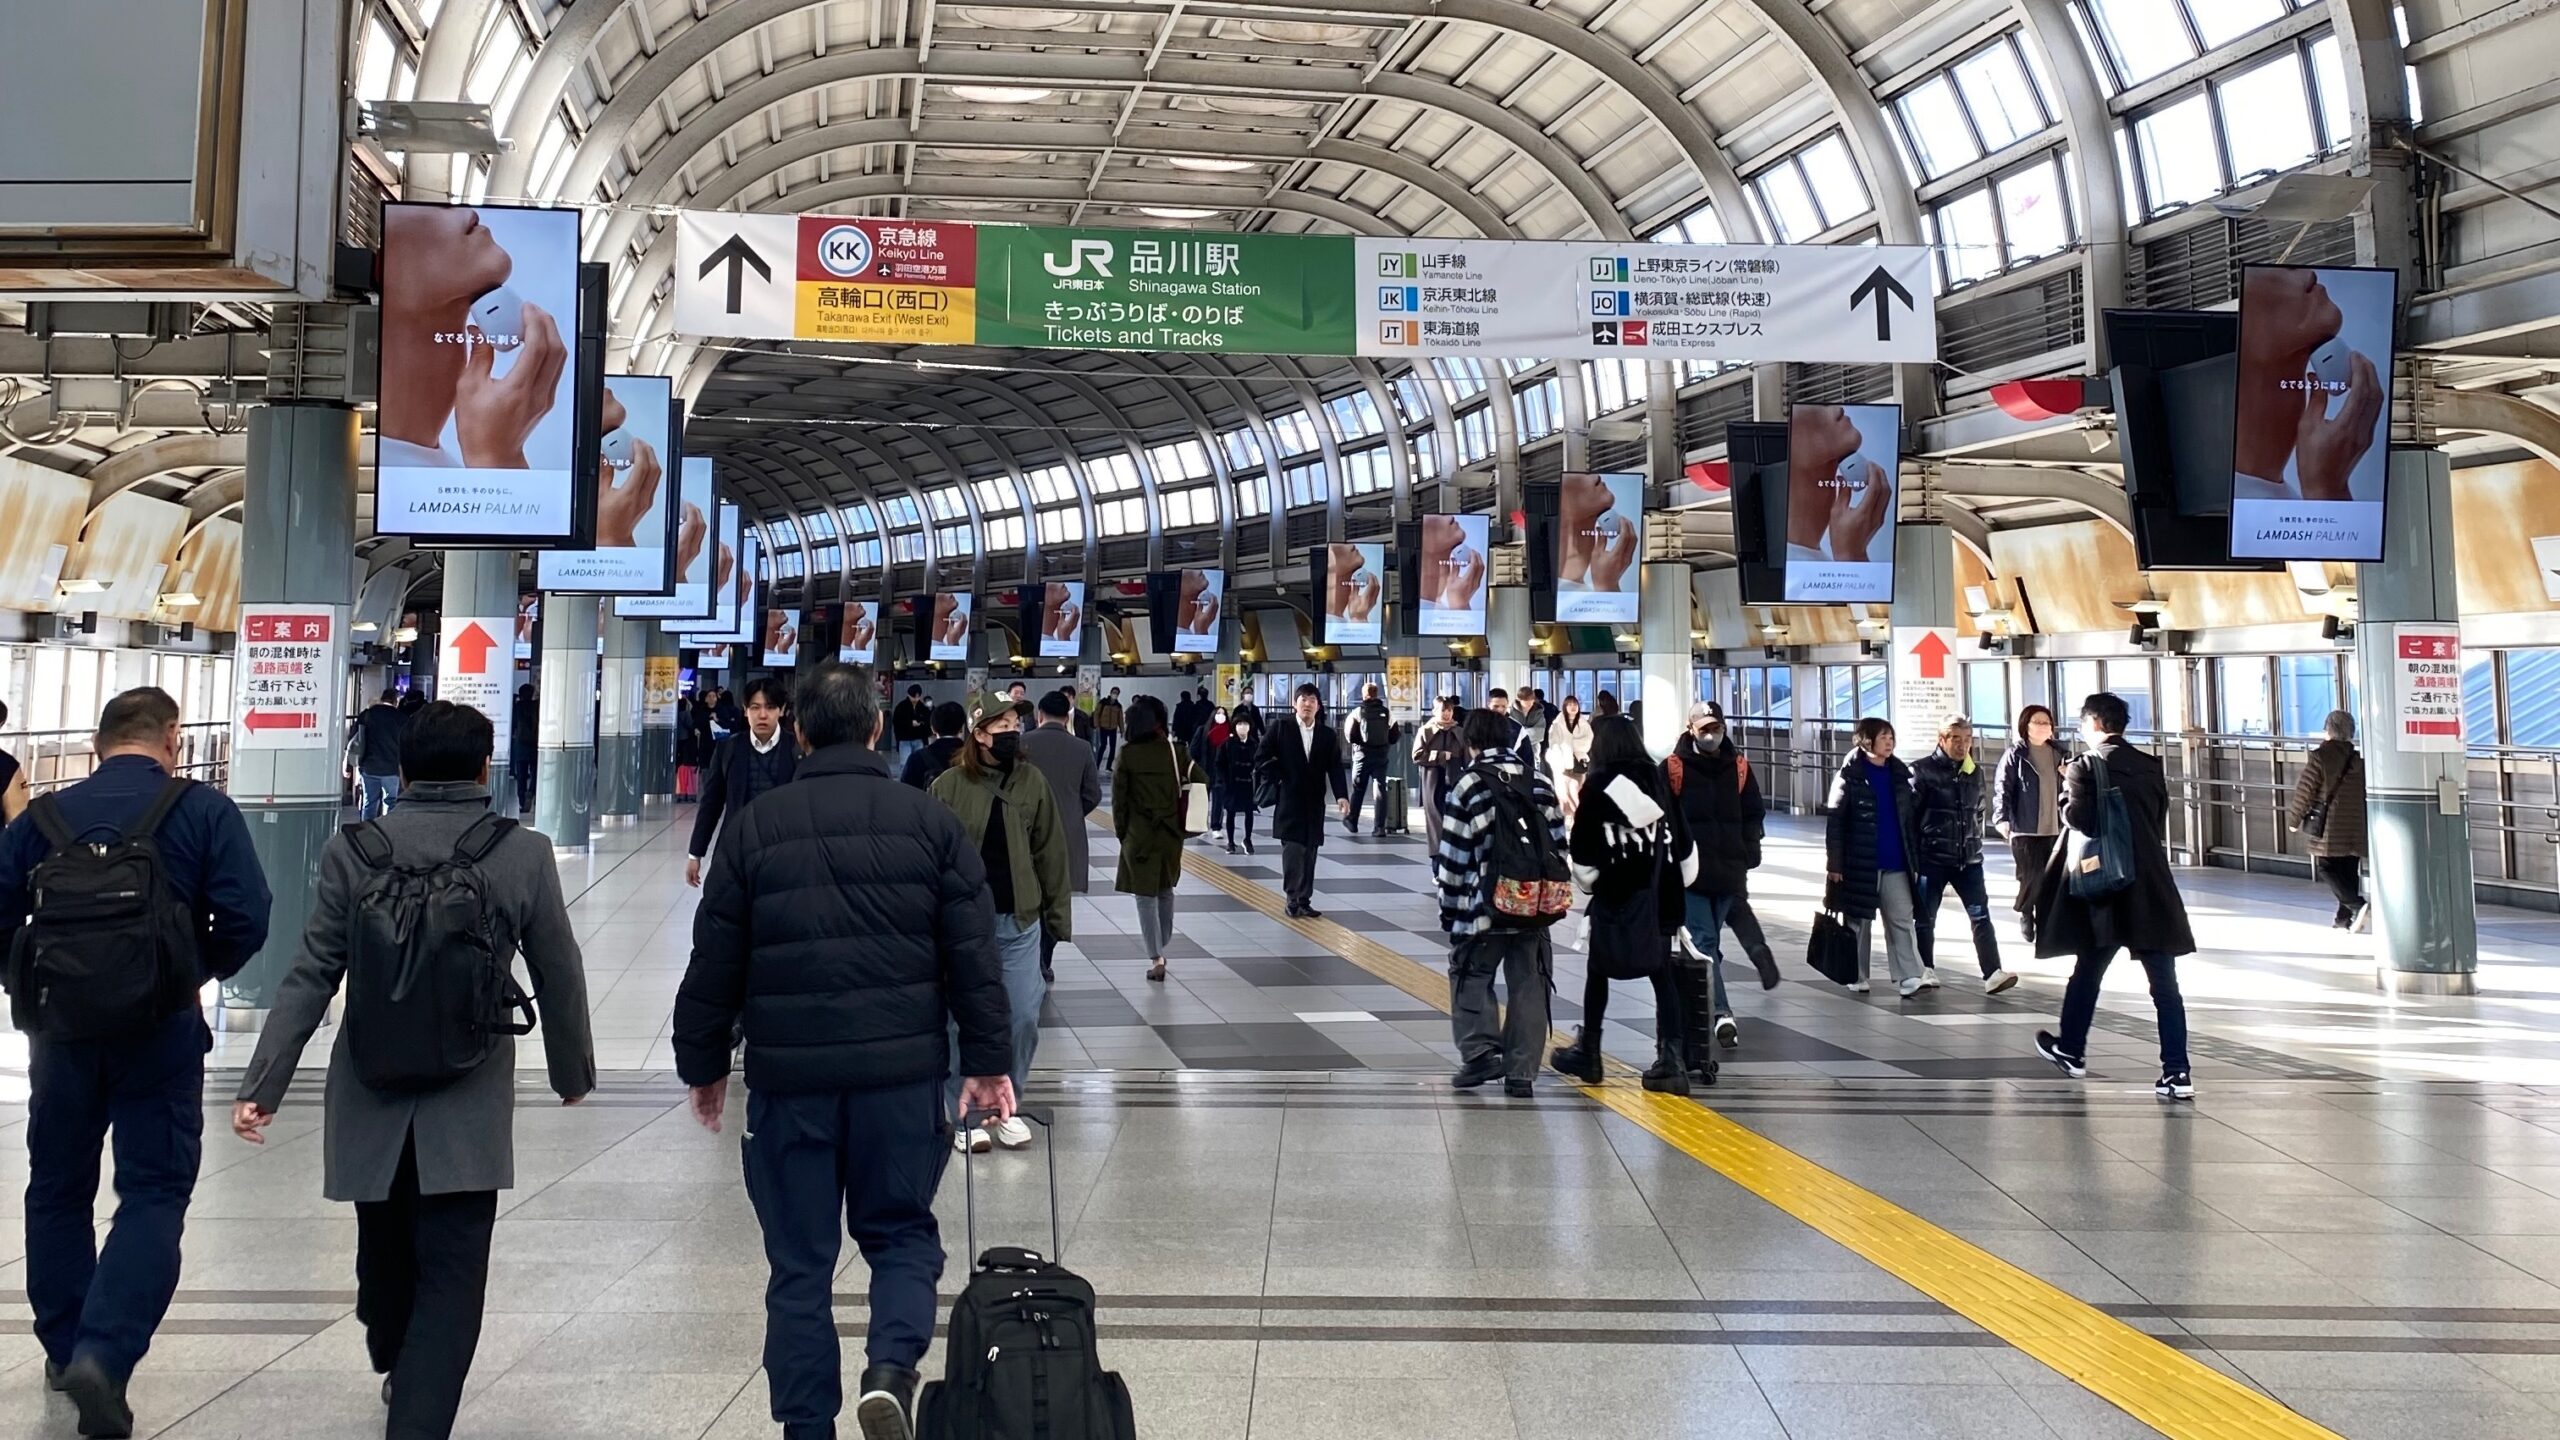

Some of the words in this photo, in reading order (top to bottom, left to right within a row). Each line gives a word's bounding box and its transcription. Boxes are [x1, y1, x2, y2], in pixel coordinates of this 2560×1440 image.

[878, 227, 937, 247] 京急線
[829, 240, 862, 261] KK
[878, 247, 916, 261] Keikyū
[920, 248, 944, 260] Line
[1044, 239, 1114, 278] JR
[1130, 240, 1240, 276] 品川駅
[1382, 259, 1399, 271] JY
[1422, 254, 1467, 269] 山手線
[1595, 263, 1609, 276] JJ
[1633, 258, 1780, 274] 上野東京ライン(常磐線)
[1422, 271, 1463, 280] Yamanote
[1465, 271, 1483, 280] Line
[1053, 279, 1104, 291] JR東日本
[1128, 279, 1207, 296] Shinagawa
[1212, 281, 1261, 296] Station
[817, 286, 948, 312] 高輪口(西口)
[1383, 293, 1399, 305] JK
[1422, 287, 1497, 303] 京浜東北線
[1482, 306, 1499, 315] Line
[1594, 297, 1613, 310] JO
[817, 310, 870, 323] Takanawa
[872, 312, 892, 324] Exit
[894, 313, 924, 325] (West
[926, 314, 949, 327] Exit)
[1044, 301, 1244, 325] きっぷうりば・のりば
[1708, 308, 1726, 317] Line
[1729, 308, 1761, 318] (Rapid)
[1043, 324, 1112, 344] Tickets
[1118, 327, 1153, 345] and
[1159, 328, 1223, 347] Tracks
[1384, 327, 1399, 338] JT
[1423, 321, 1480, 337] 東海道線
[1652, 321, 1763, 336] 成田エクスプレス
[1462, 338, 1481, 347] Line
[1652, 338, 1679, 347] Narita
[1681, 338, 1716, 348] Express
[408, 501, 481, 514] LAMDASH
[485, 502, 523, 515] PALM
[525, 503, 541, 516] IN
[2256, 530, 2313, 541] LAMDASH
[2315, 530, 2346, 541] PALM
[2346, 531, 2359, 541] IN
[558, 568, 605, 577] LAMDASH
[607, 569, 633, 577] PALM
[1802, 581, 1843, 590] LAMDASH
[251, 620, 320, 638] ご案内
[249, 646, 321, 659] 朝の混雑時は
[252, 661, 314, 675] 通路両端を
[248, 680, 318, 692] ご通行下さい
